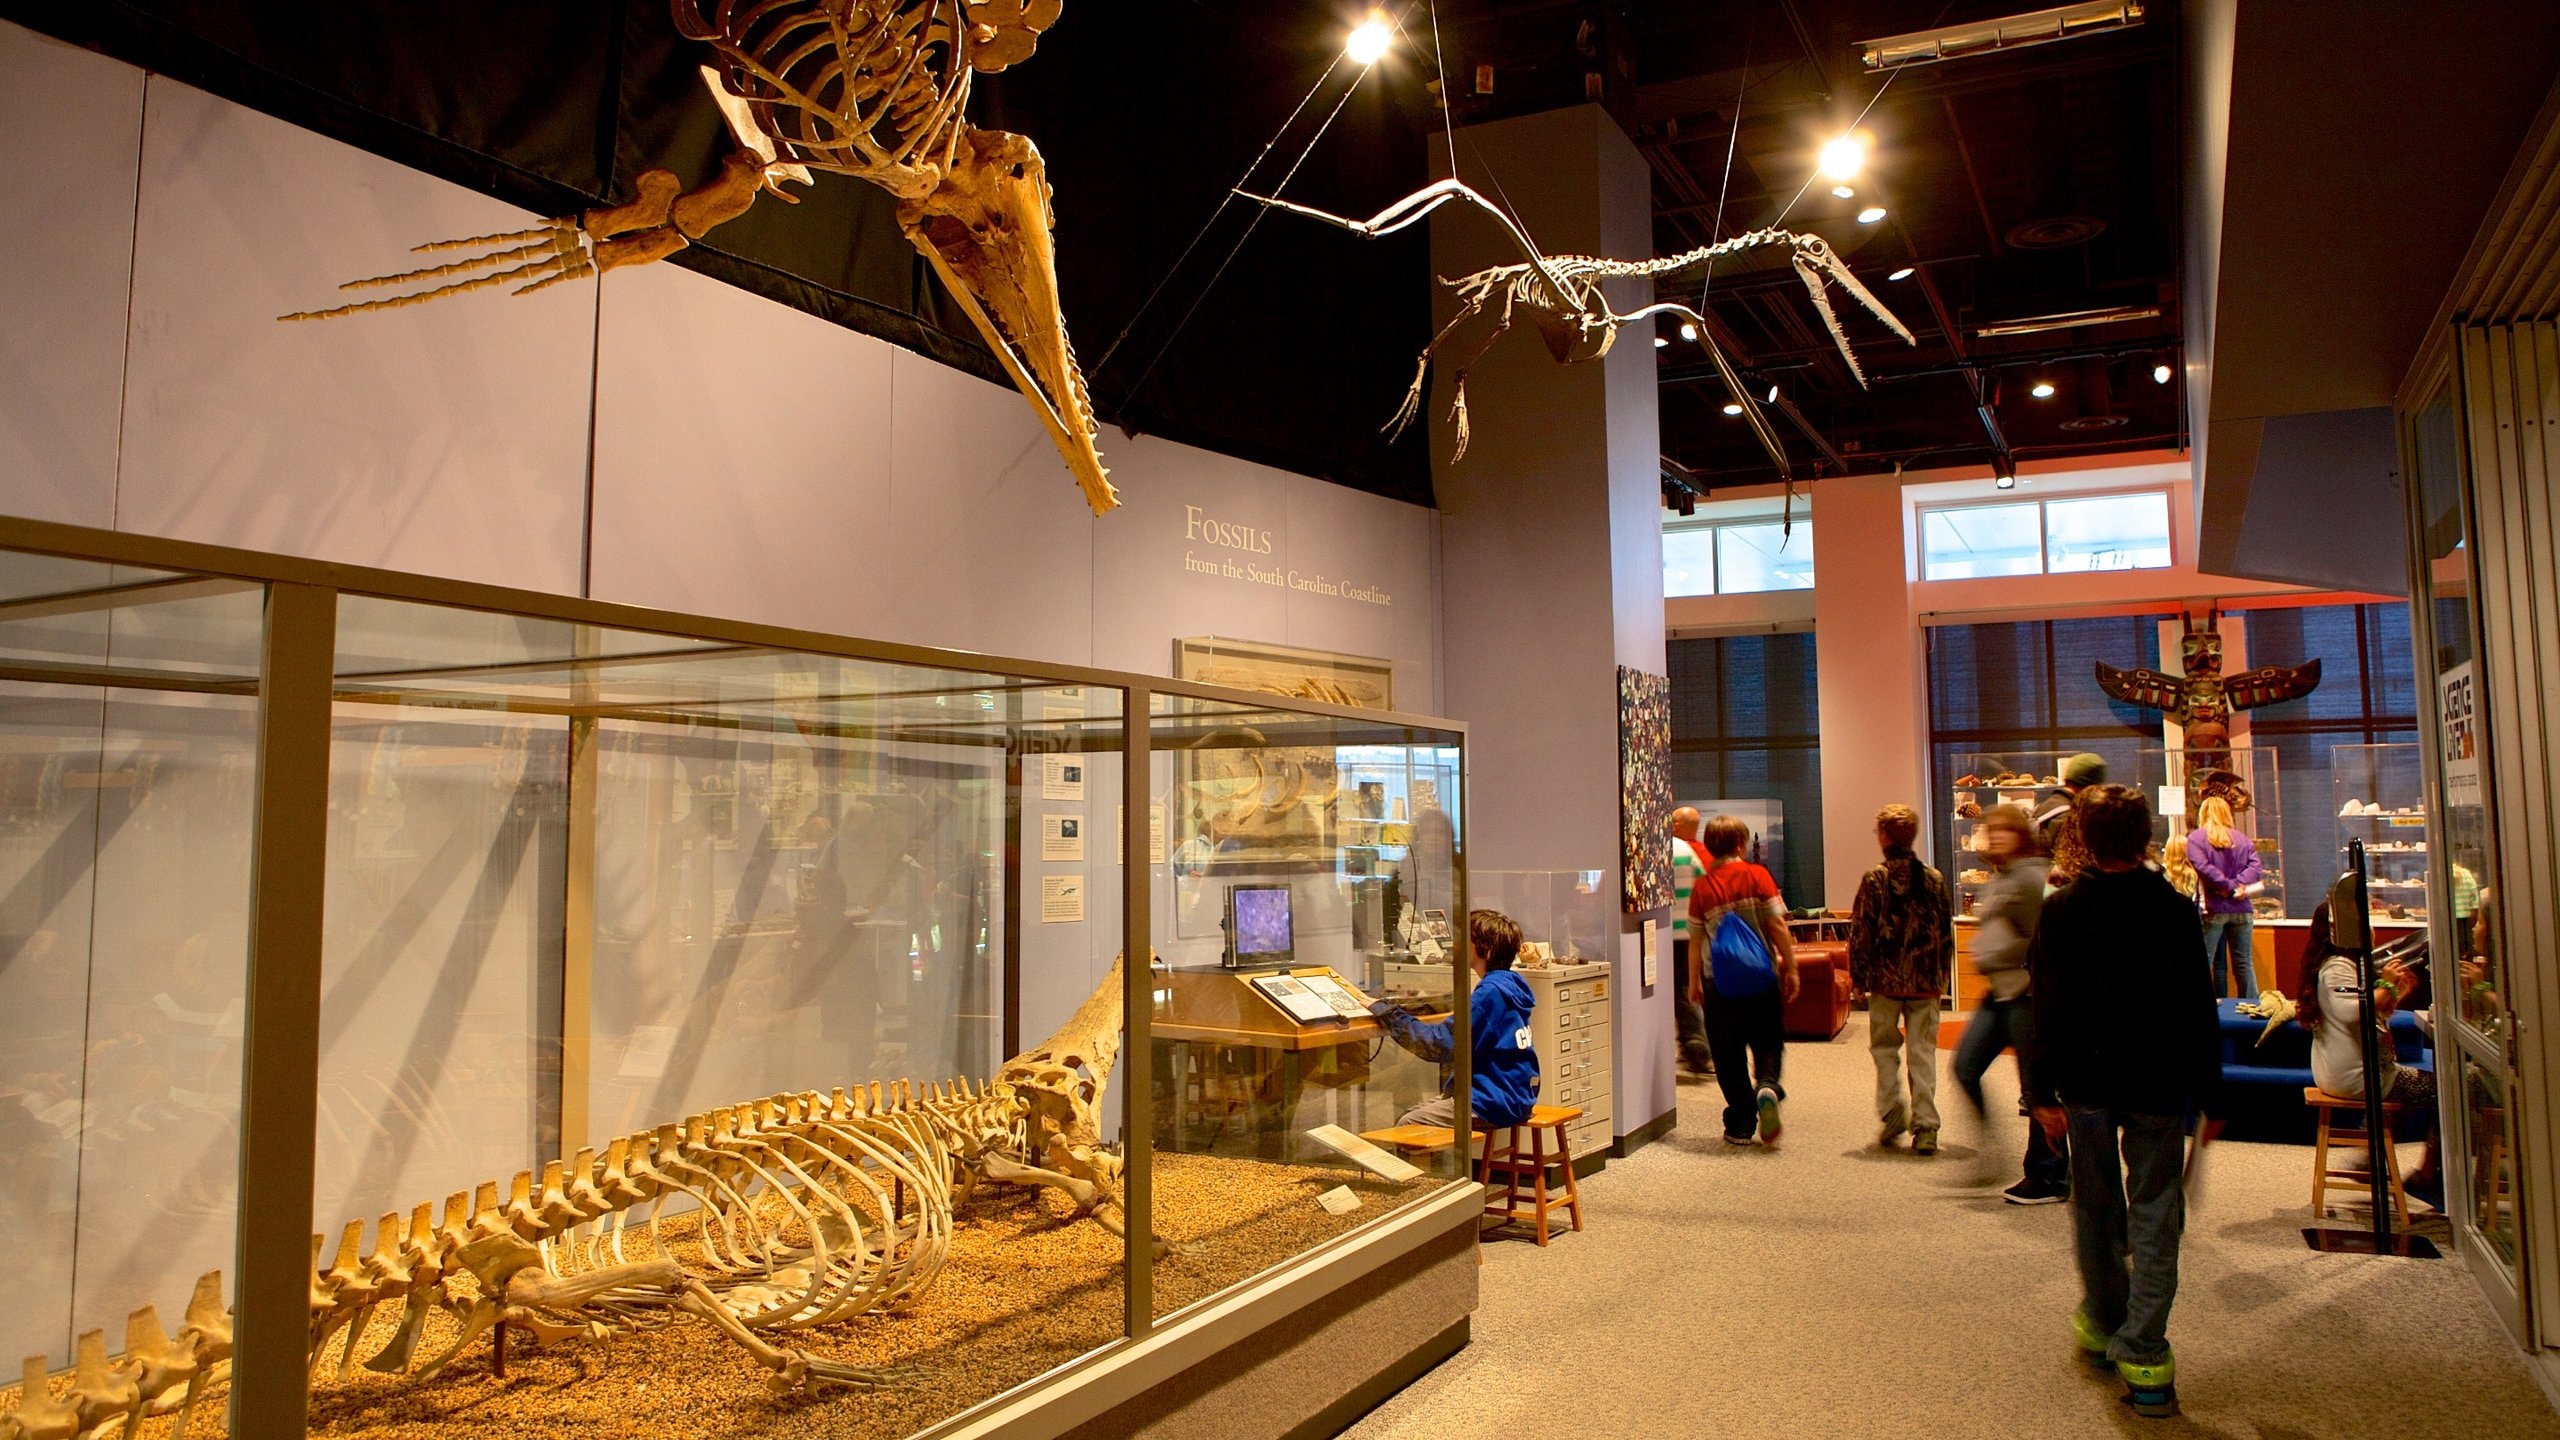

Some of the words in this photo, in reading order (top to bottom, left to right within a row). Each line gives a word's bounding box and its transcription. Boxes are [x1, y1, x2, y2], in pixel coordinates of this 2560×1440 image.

[1185, 504, 1272, 555] FOSSILS
[1185, 551, 1218, 575] from
[1223, 558, 1243, 579] the
[1247, 562, 1284, 587] South
[1287, 570, 1338, 596] Carolina
[1341, 580, 1391, 606] Coastline
